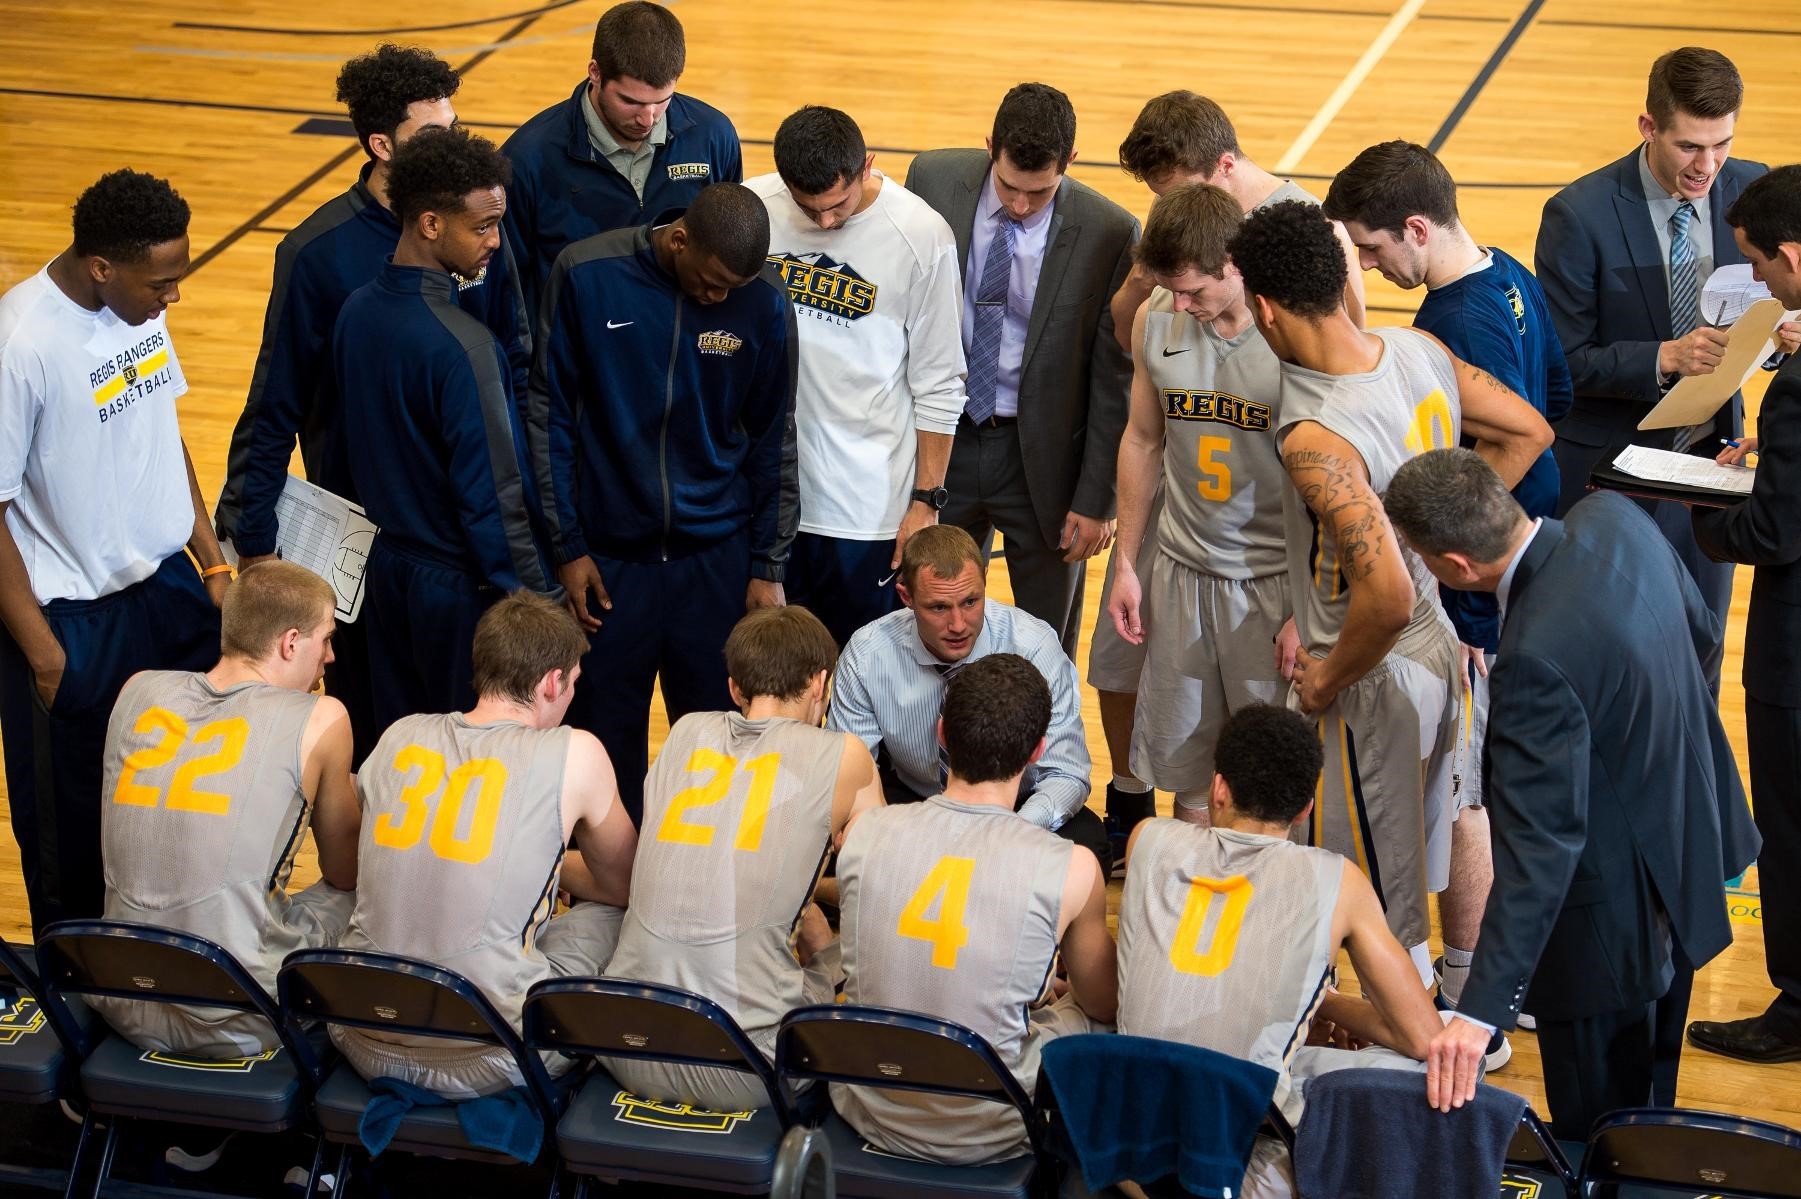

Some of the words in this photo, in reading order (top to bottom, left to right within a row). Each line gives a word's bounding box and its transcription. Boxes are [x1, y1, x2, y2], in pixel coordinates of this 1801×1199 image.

[669, 164, 709, 176] REGIS
[791, 292, 854, 318] VERSITY
[798, 307, 850, 328] ETBALL
[90, 357, 116, 388] REGIS
[116, 332, 164, 370] RANGERS
[699, 335, 742, 350] REGIS
[1163, 389, 1271, 432] REGIS
[1198, 435, 1232, 502] 5
[113, 706, 249, 815] 22
[374, 744, 507, 864] 30
[657, 748, 781, 852] 21
[898, 856, 976, 970] 4
[1170, 874, 1254, 977] 0
